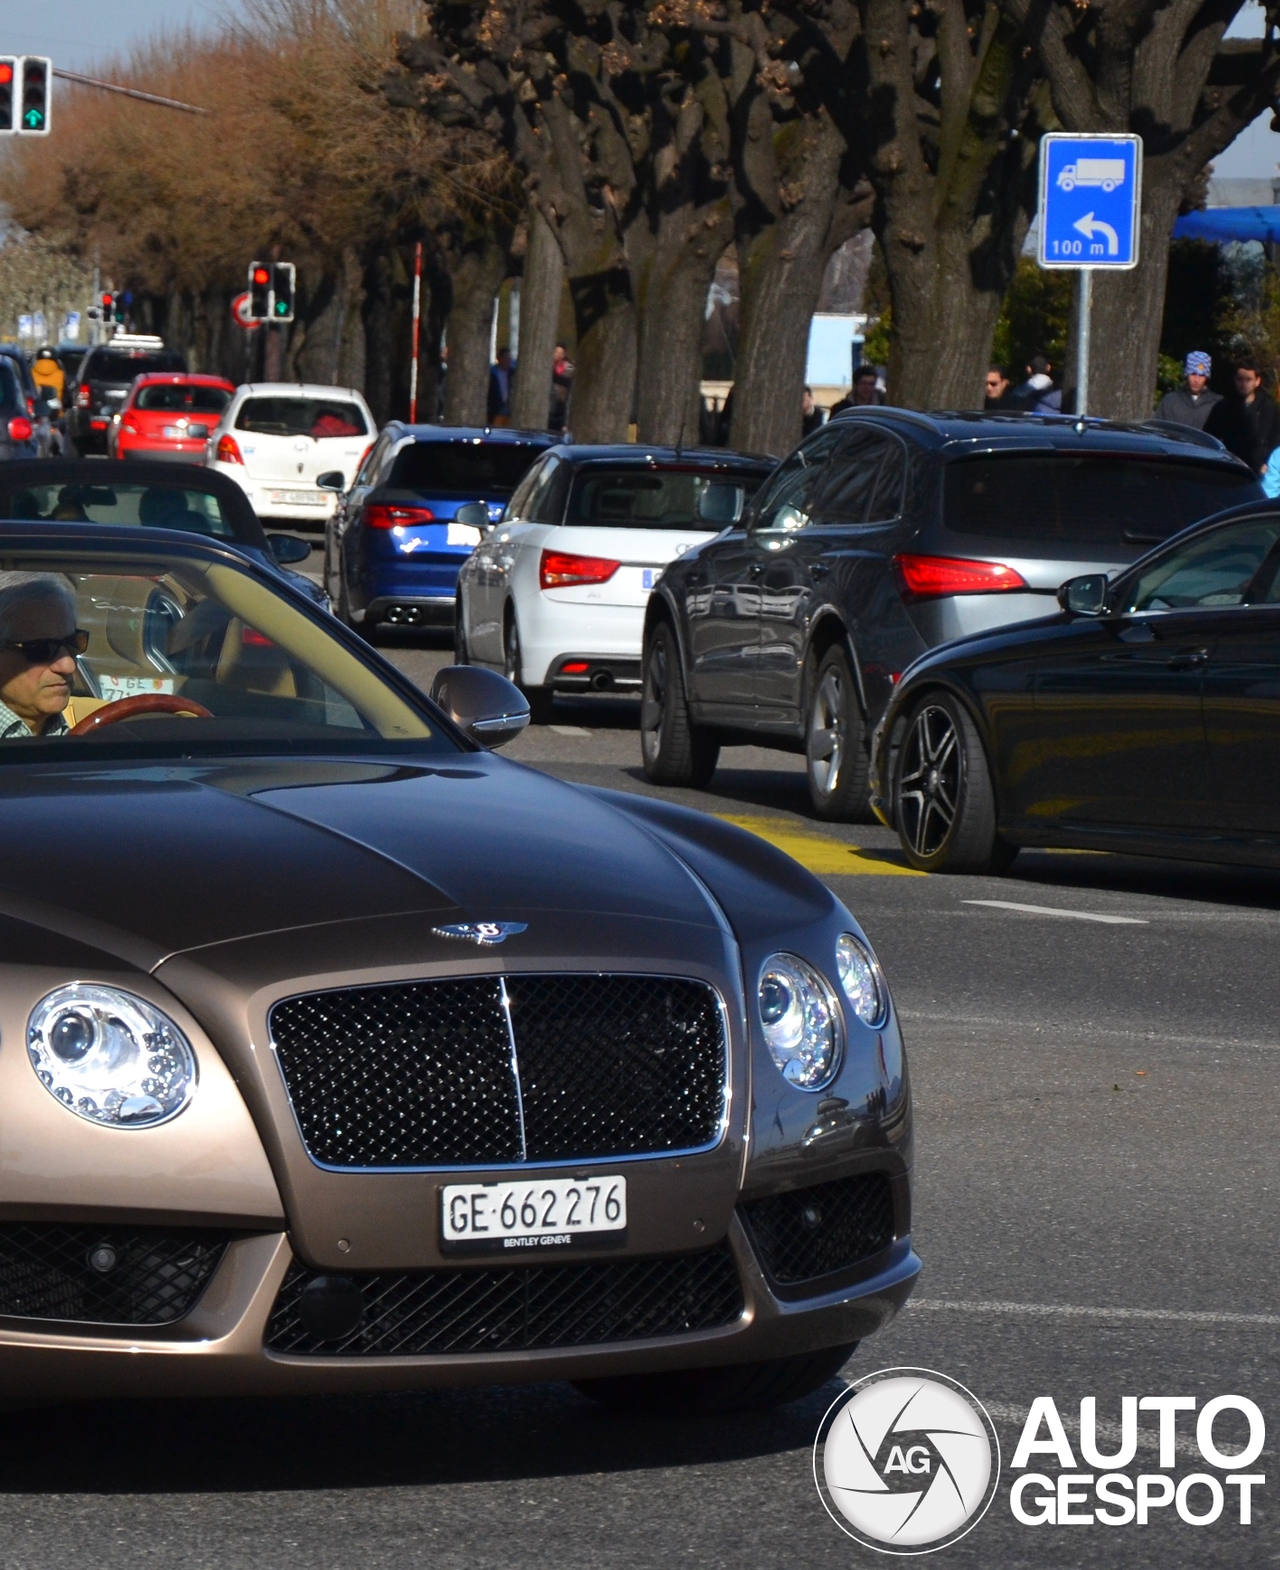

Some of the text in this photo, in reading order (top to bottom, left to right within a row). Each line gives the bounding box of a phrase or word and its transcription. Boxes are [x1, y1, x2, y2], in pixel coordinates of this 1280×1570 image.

[1052, 239, 1105, 255] 100 m
[126, 677, 146, 689] GE
[503, 1234, 572, 1248] BENTLEY GENEVE
